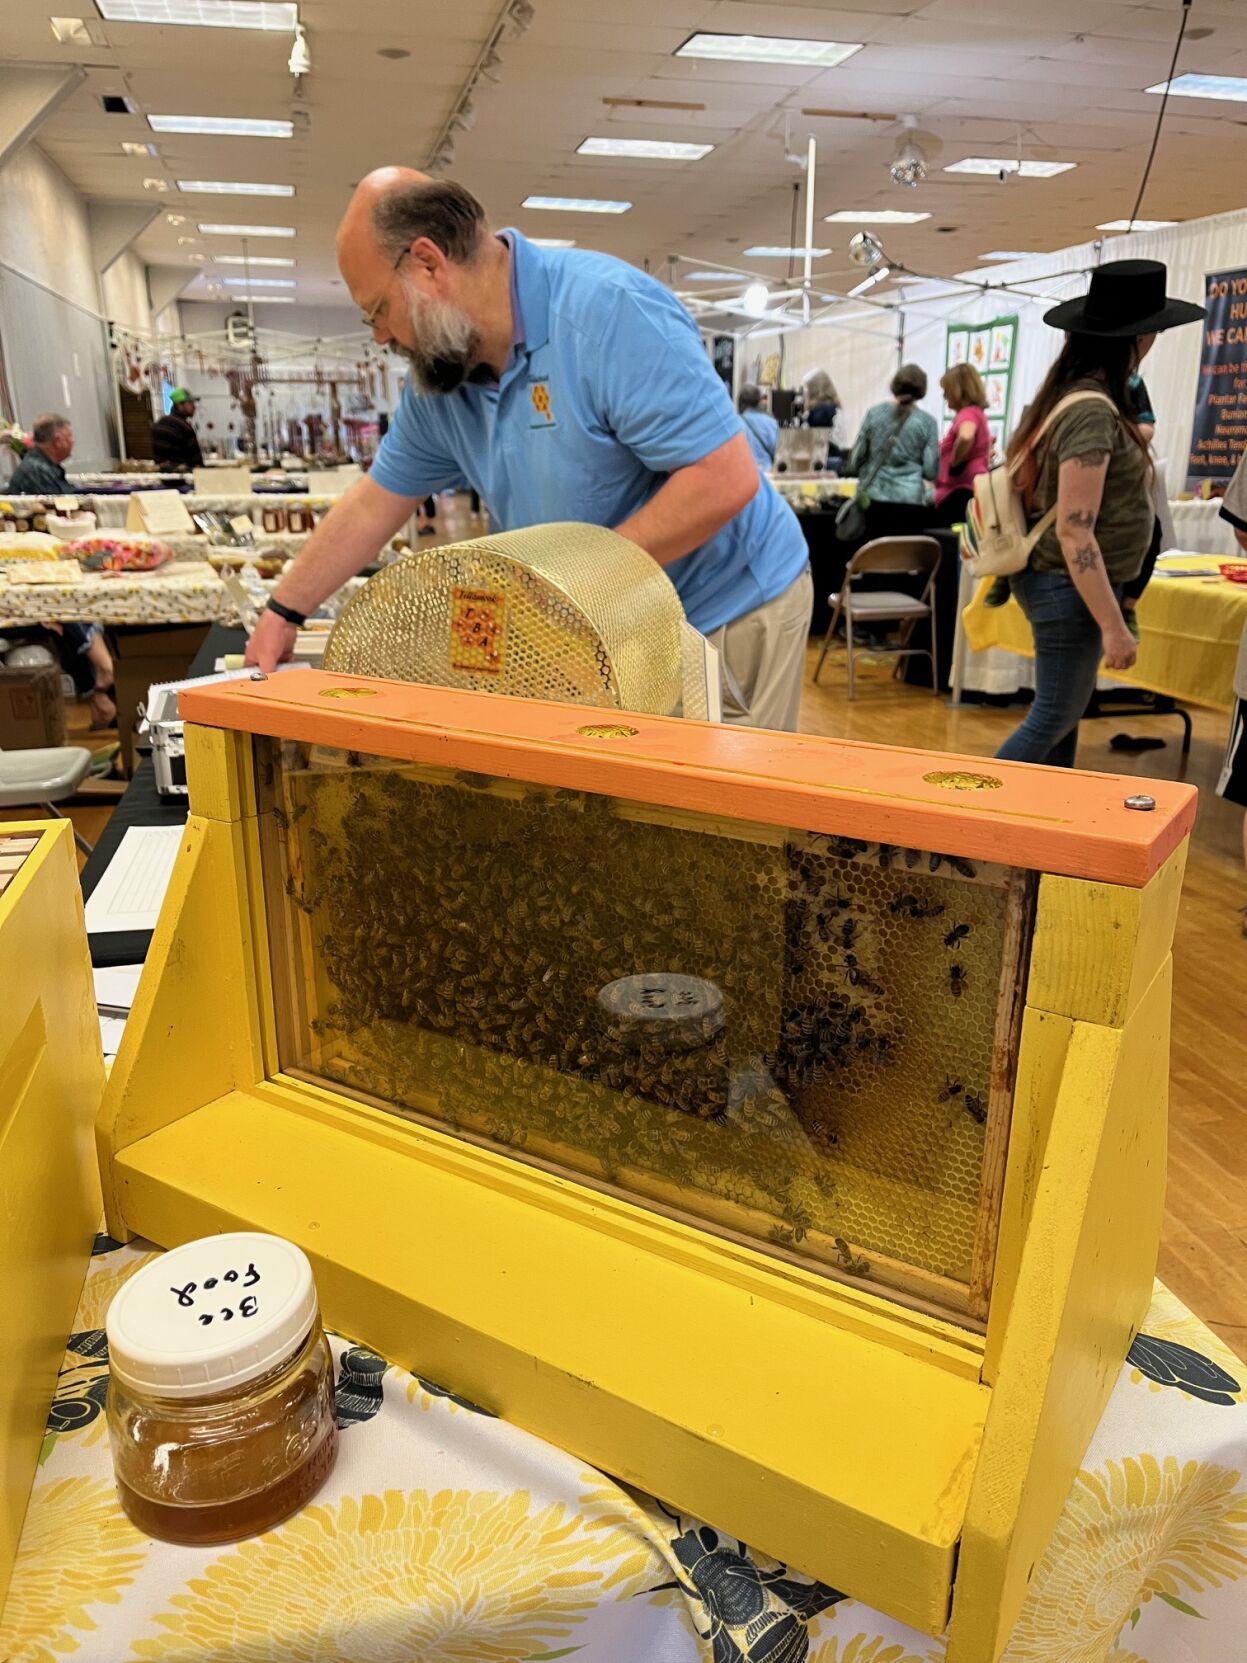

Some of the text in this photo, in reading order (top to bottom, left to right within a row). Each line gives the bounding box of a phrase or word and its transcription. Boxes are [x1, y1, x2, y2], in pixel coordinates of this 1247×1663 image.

[1209, 281, 1229, 299] DO
[1206, 328, 1224, 347] WE
[199, 1296, 258, 1325] Bee
